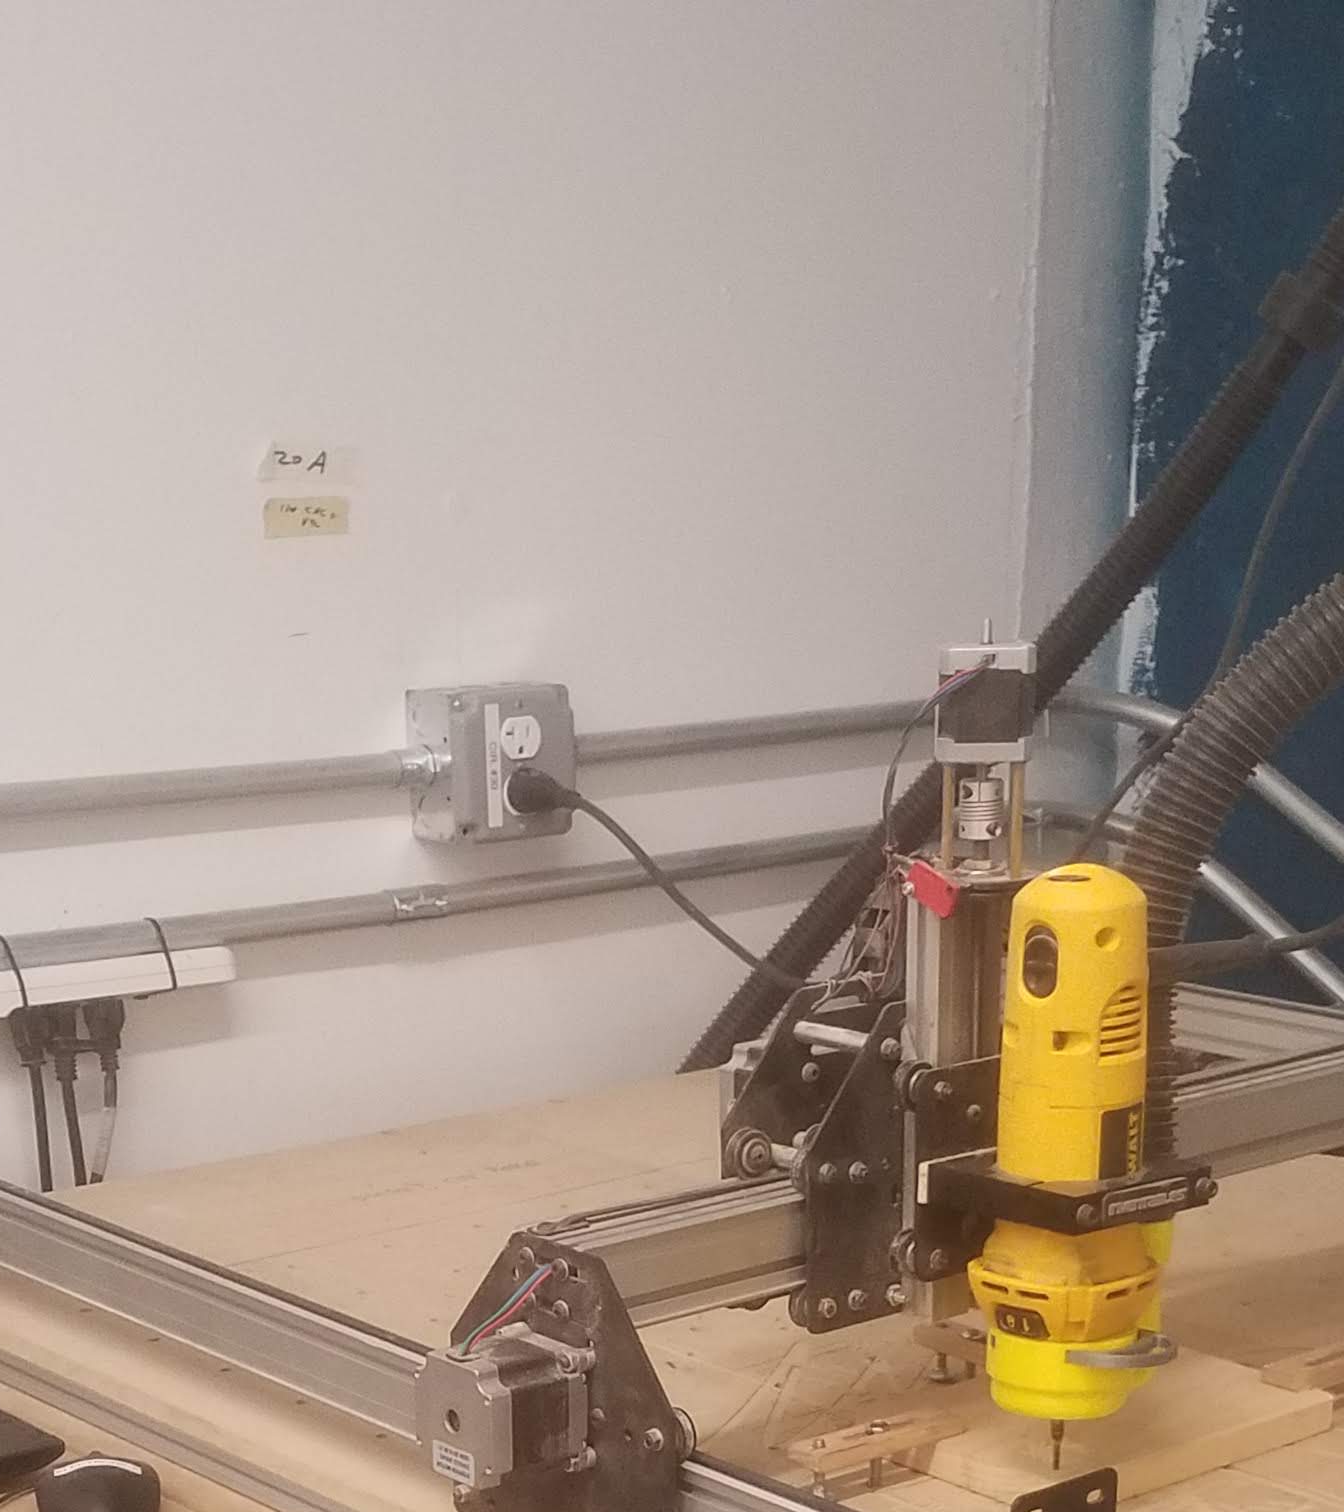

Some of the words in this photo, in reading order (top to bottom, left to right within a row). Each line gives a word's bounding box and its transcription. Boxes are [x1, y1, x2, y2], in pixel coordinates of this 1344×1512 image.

[274, 450, 302, 465] 20
[306, 450, 328, 474] A
[1127, 1111, 1140, 1176] WALT
